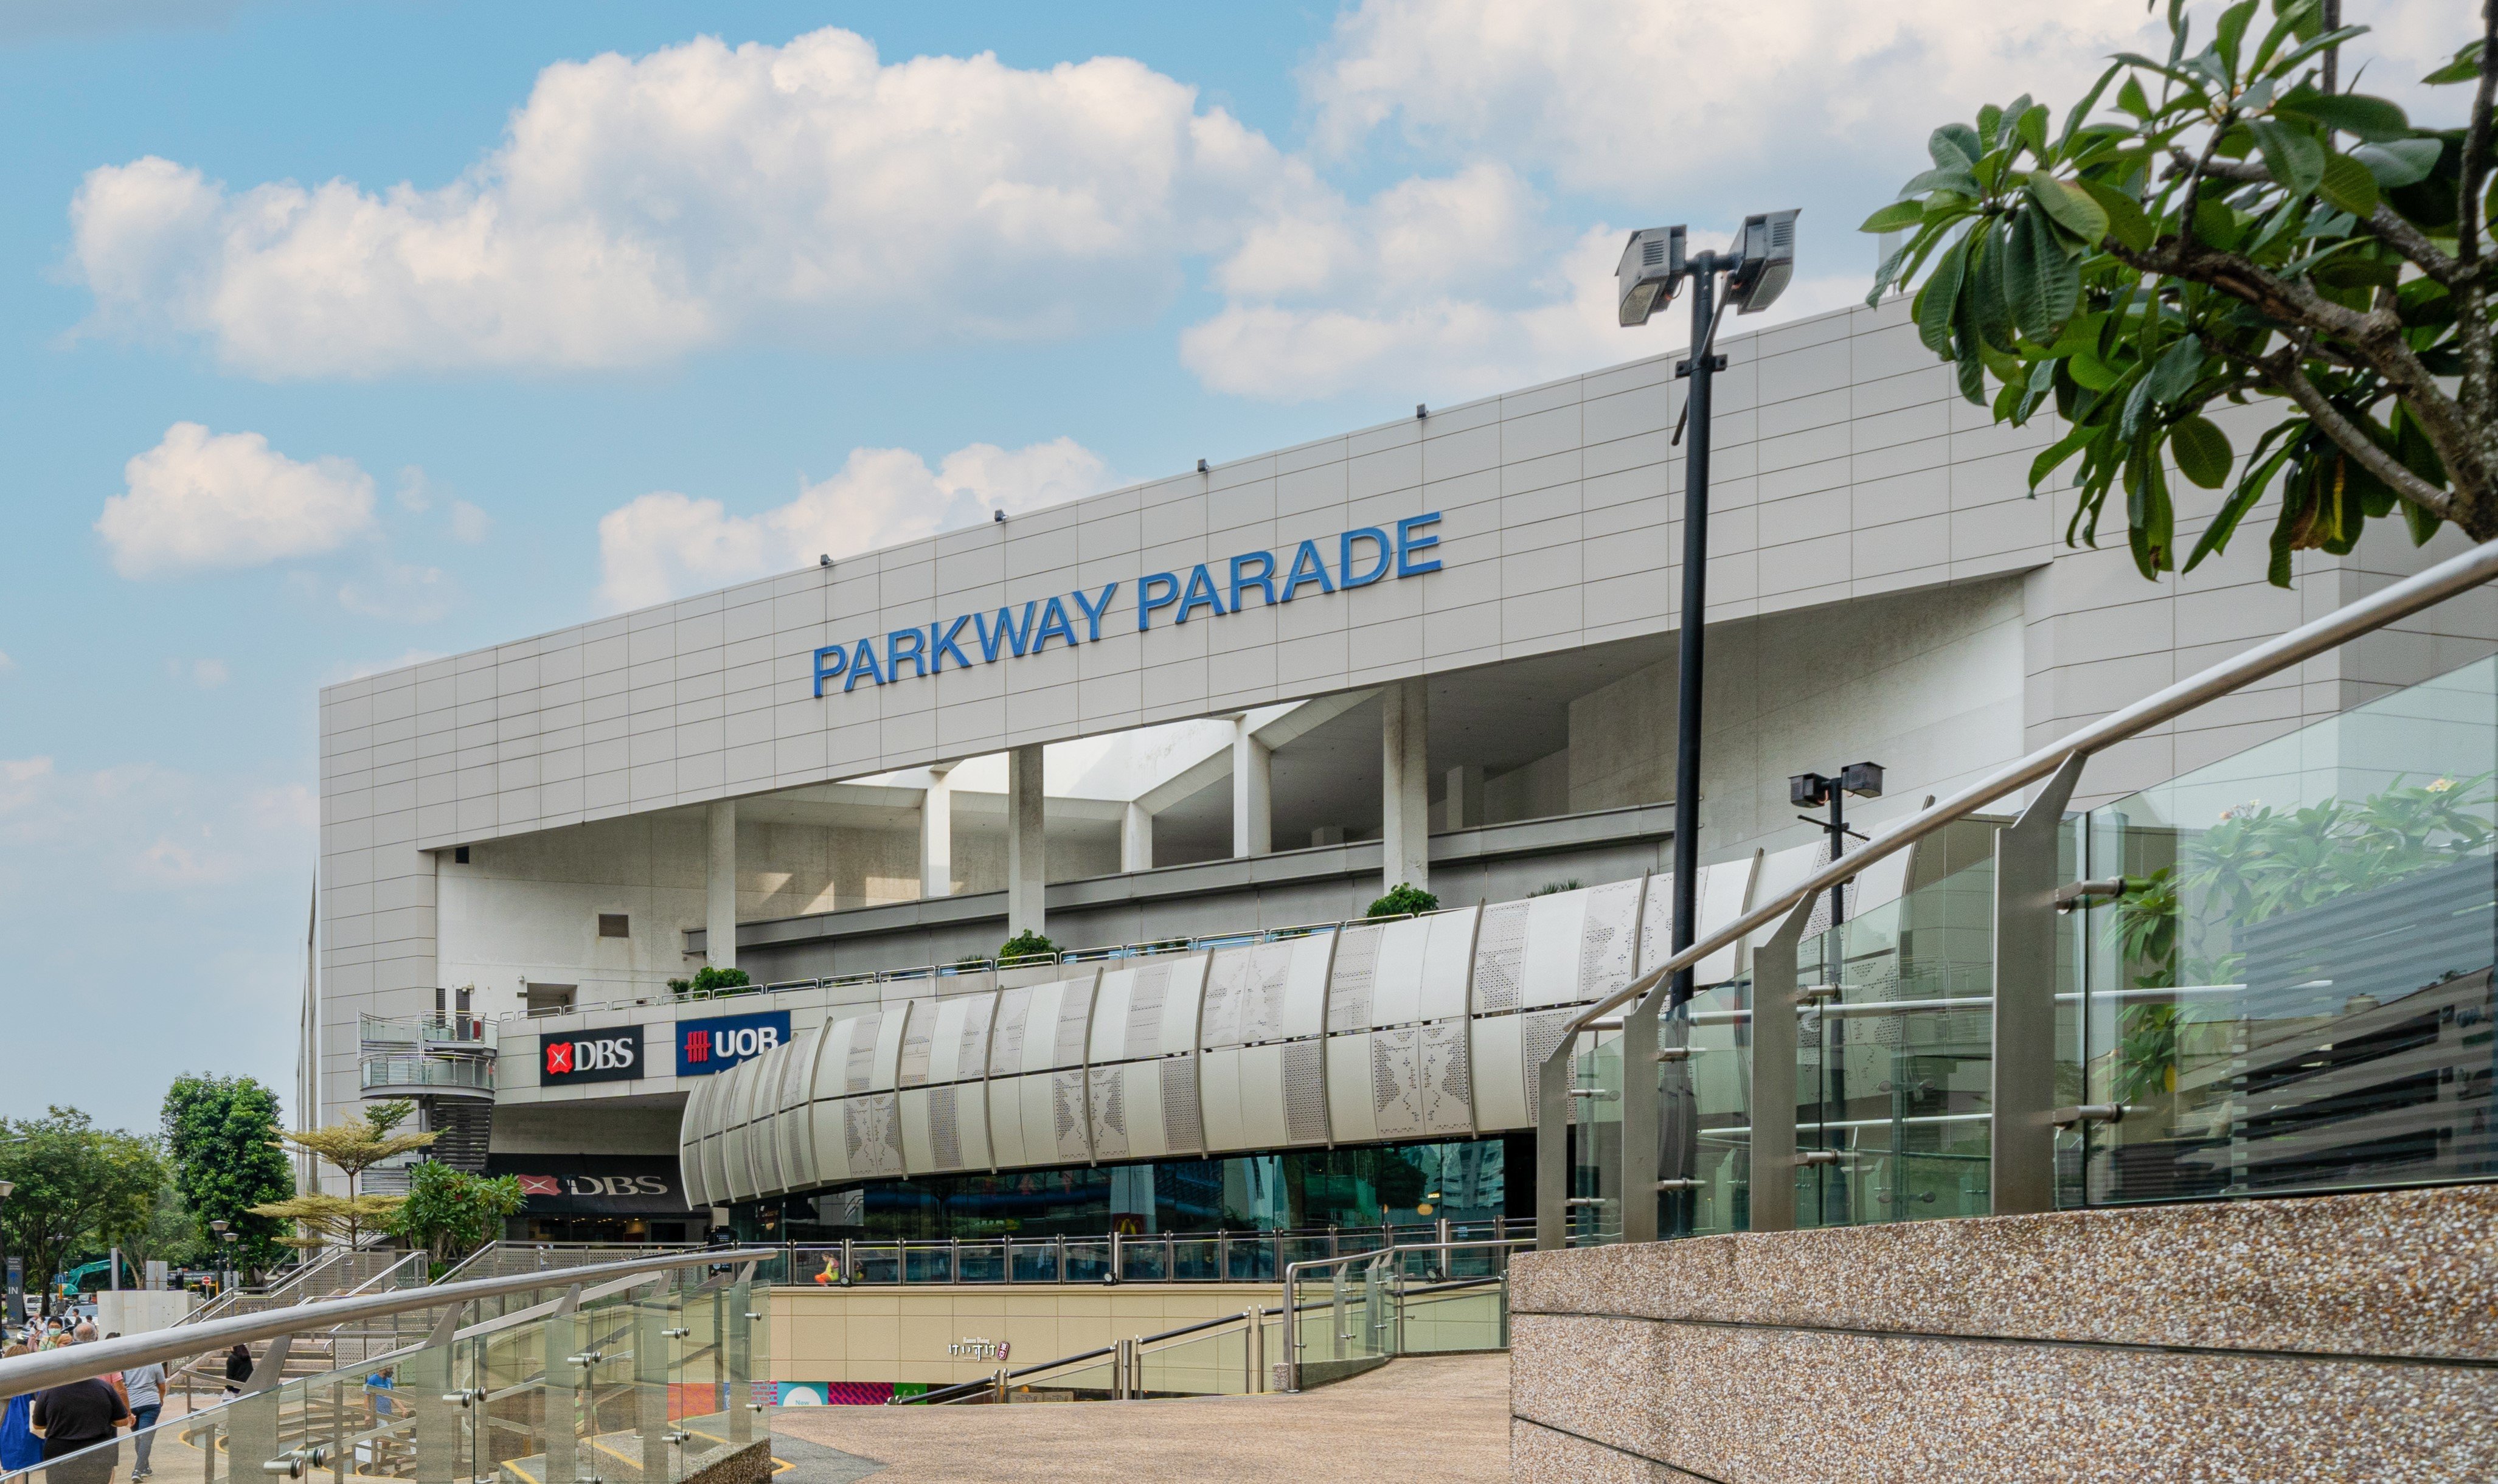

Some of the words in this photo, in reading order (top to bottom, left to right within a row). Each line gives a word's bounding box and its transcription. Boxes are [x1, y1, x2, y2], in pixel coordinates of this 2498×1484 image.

[813, 581, 1119, 698] PARKWAY
[1137, 510, 1443, 633] PARADE
[574, 1038, 634, 1072] DBS
[715, 1027, 779, 1058] UOB
[567, 1175, 668, 1196] DBS
[948, 1344, 996, 1362] けいすけ
